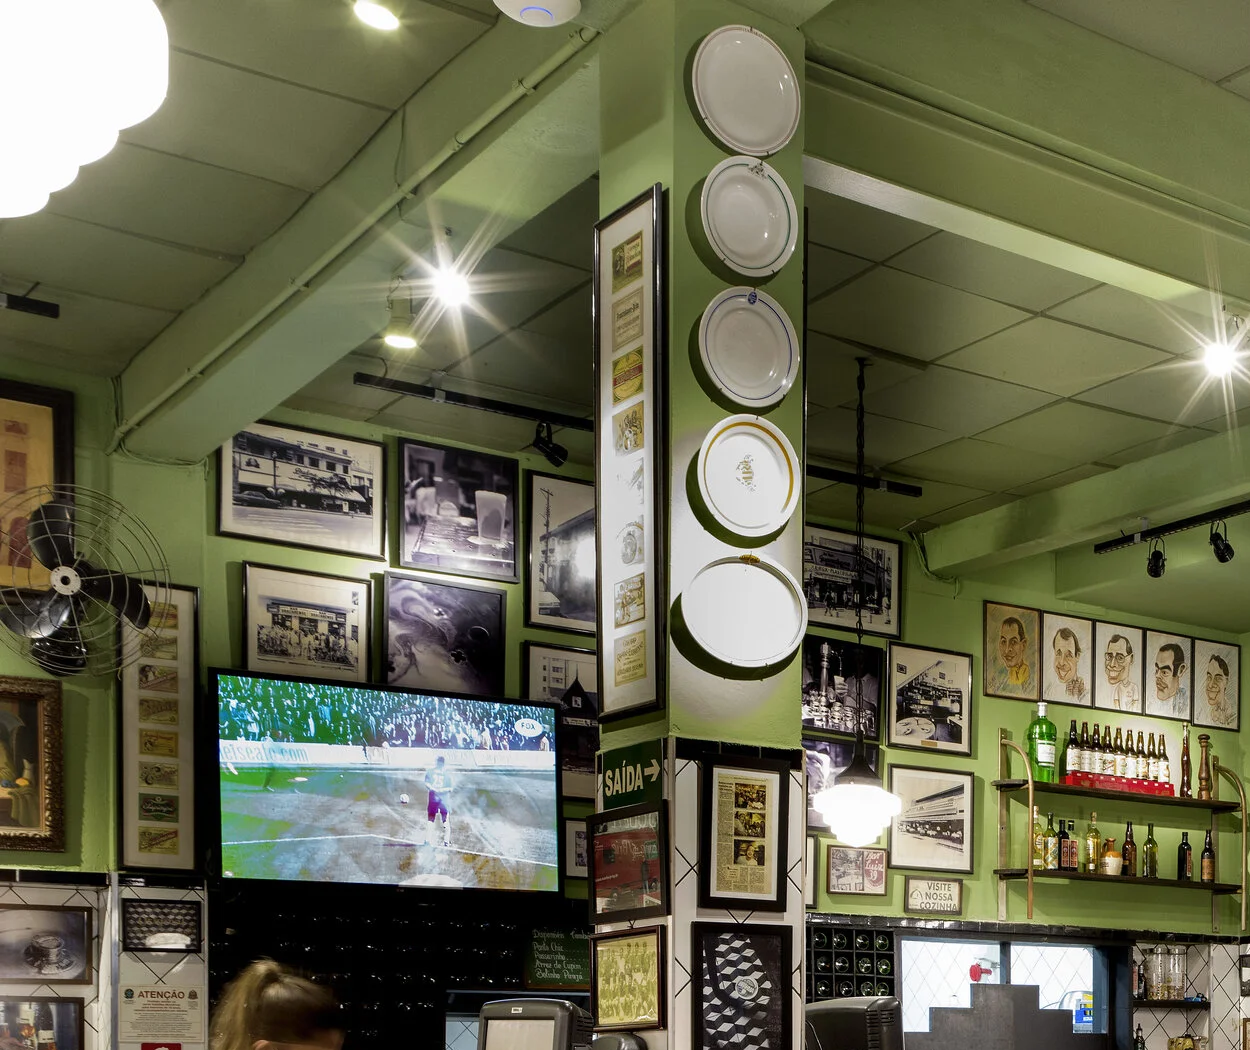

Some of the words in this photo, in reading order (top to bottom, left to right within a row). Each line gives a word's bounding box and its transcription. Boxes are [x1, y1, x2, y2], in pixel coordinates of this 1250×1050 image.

[520, 722, 536, 731] FOX
[604, 760, 644, 797] SAÍDA
[927, 881, 952, 892] VISITE
[925, 892, 953, 902] NOSSA
[919, 901, 958, 912] COZINHA
[138, 989, 185, 1001] ATENÇÃO
